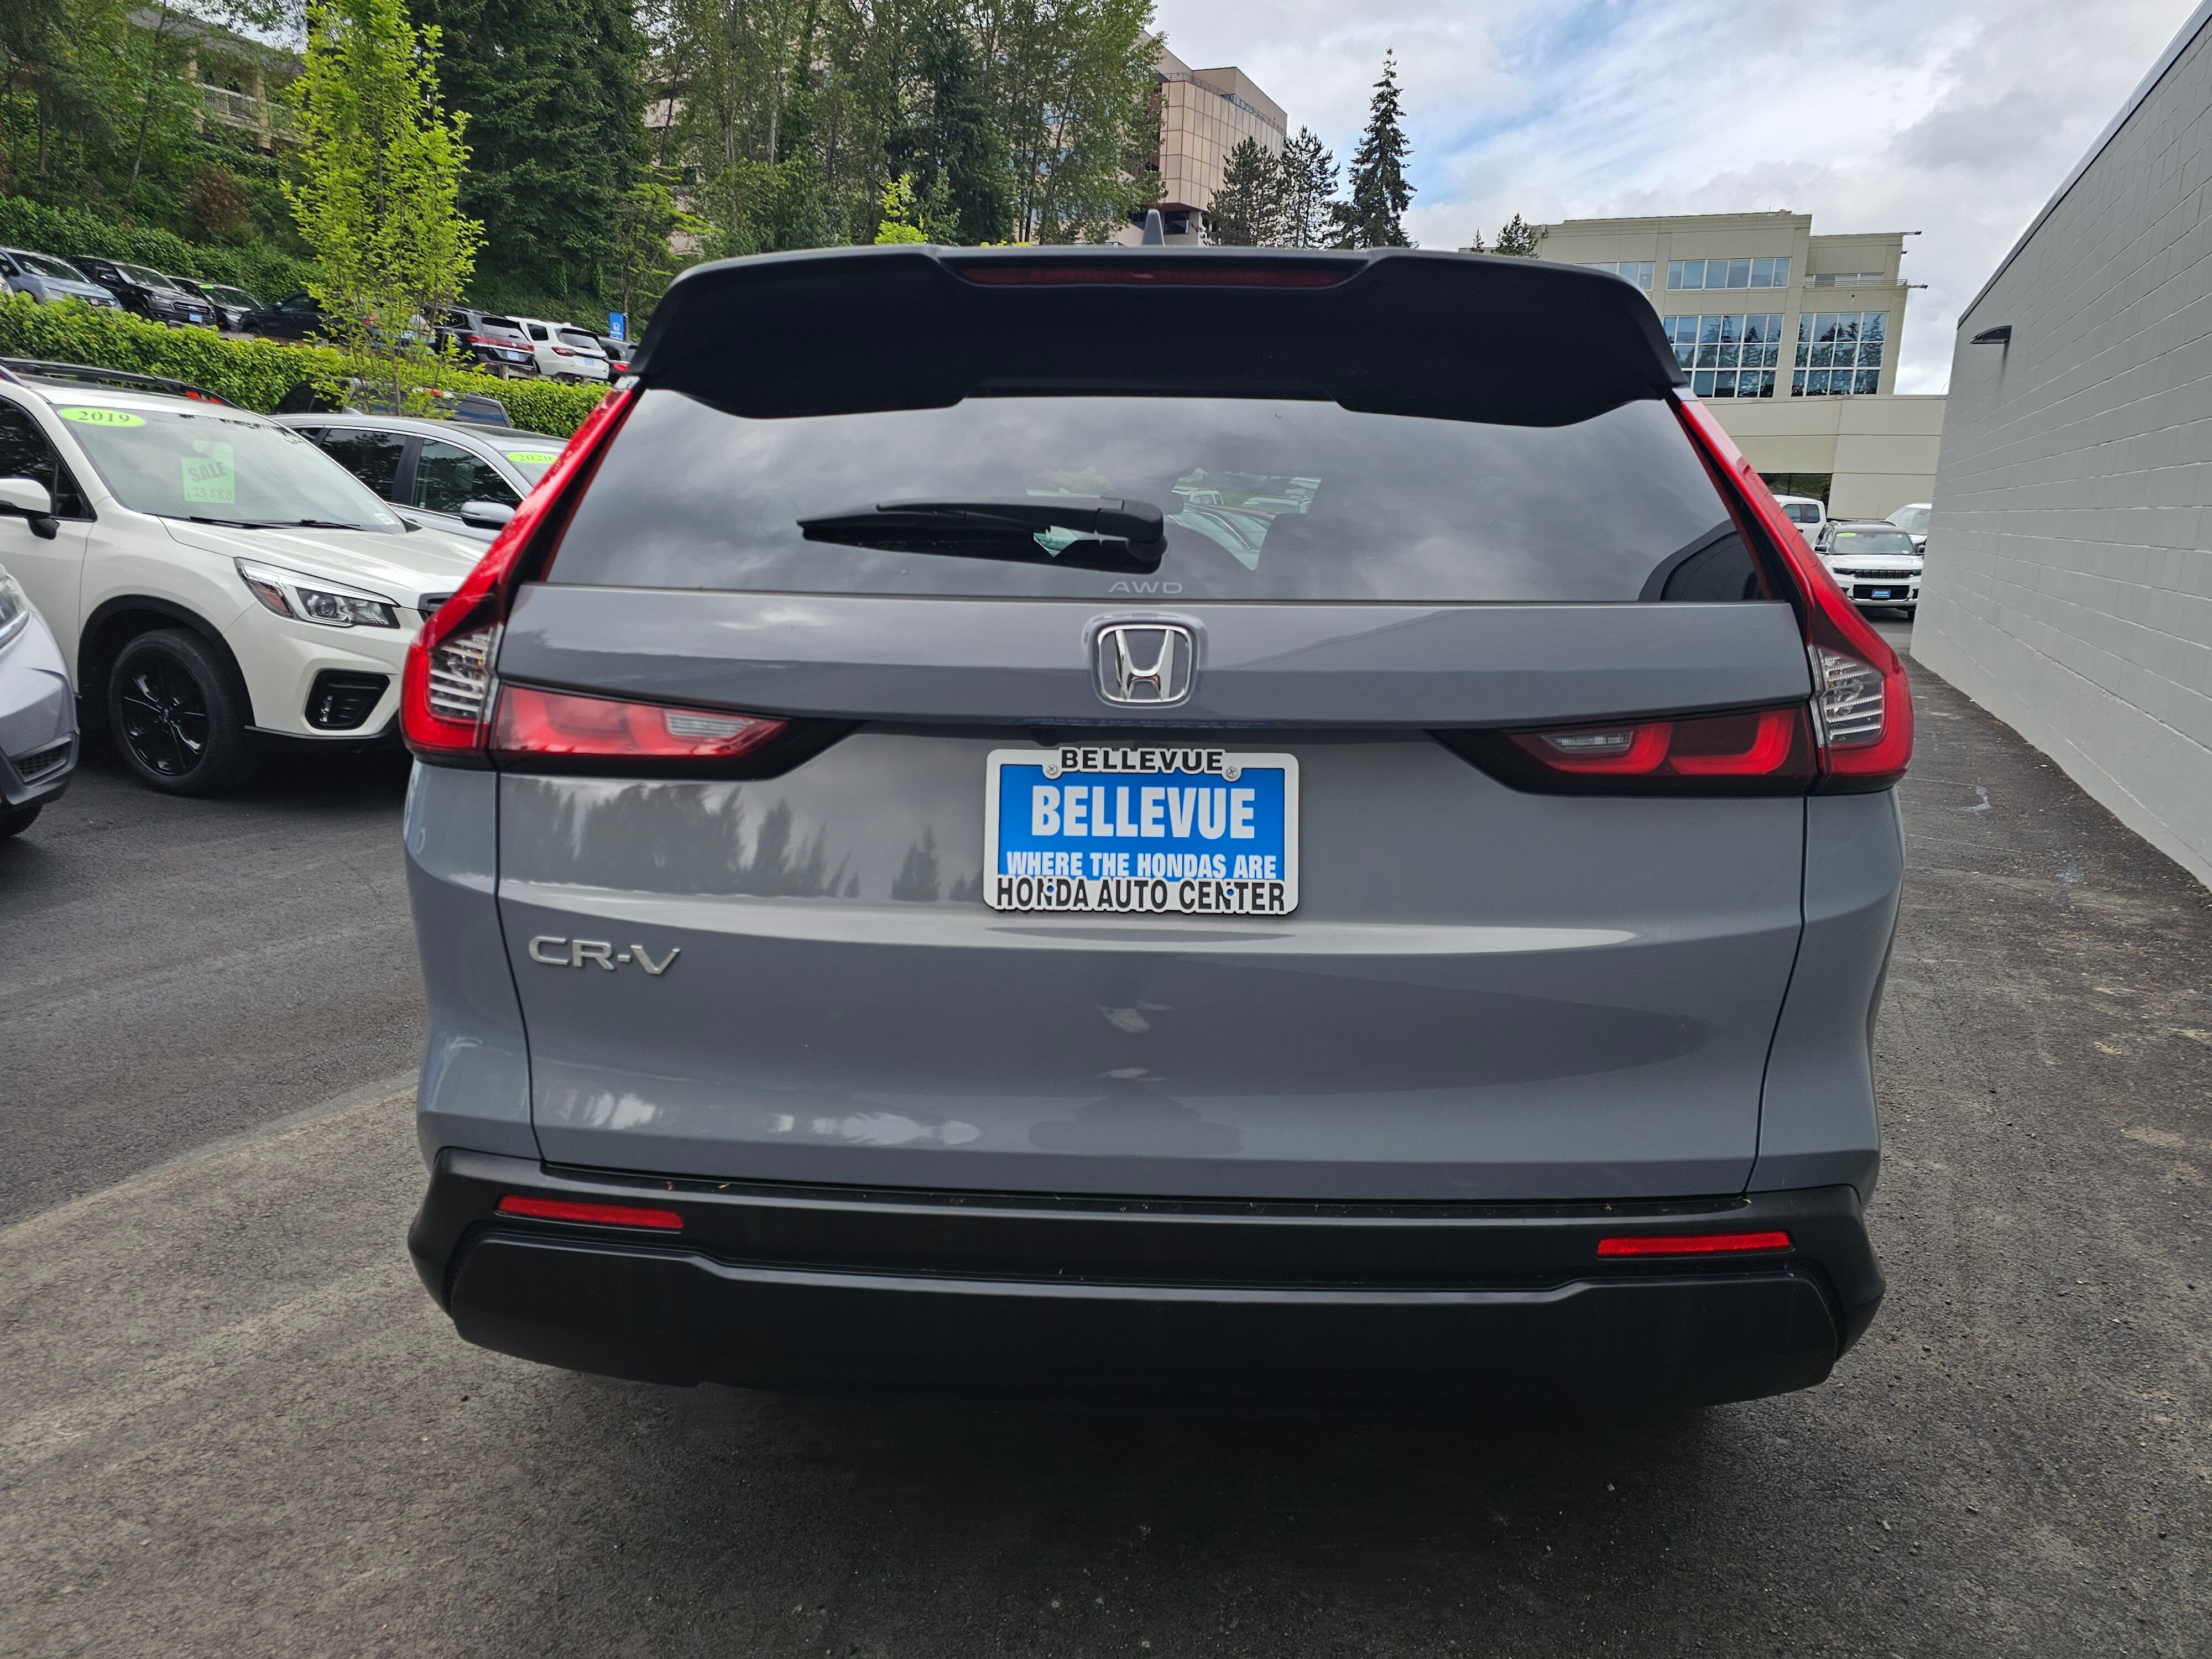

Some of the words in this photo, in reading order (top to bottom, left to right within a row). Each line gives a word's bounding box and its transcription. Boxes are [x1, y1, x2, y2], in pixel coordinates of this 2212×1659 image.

[77, 411, 130, 423] 2019
[187, 462, 228, 483] SALE
[1108, 581, 1183, 594] AWD
[1061, 749, 1223, 771] BELLEVUE
[1031, 785, 1255, 839] BELLEVUE
[1006, 851, 1083, 877] WHERE
[1090, 852, 1130, 878] THE
[1138, 852, 1227, 879] HONDAS
[1233, 854, 1277, 879] ARE
[997, 877, 1089, 909] HONDA
[1097, 879, 1168, 910] AUTO
[1178, 881, 1285, 912] CENTER
[529, 936, 681, 975] CR-V
